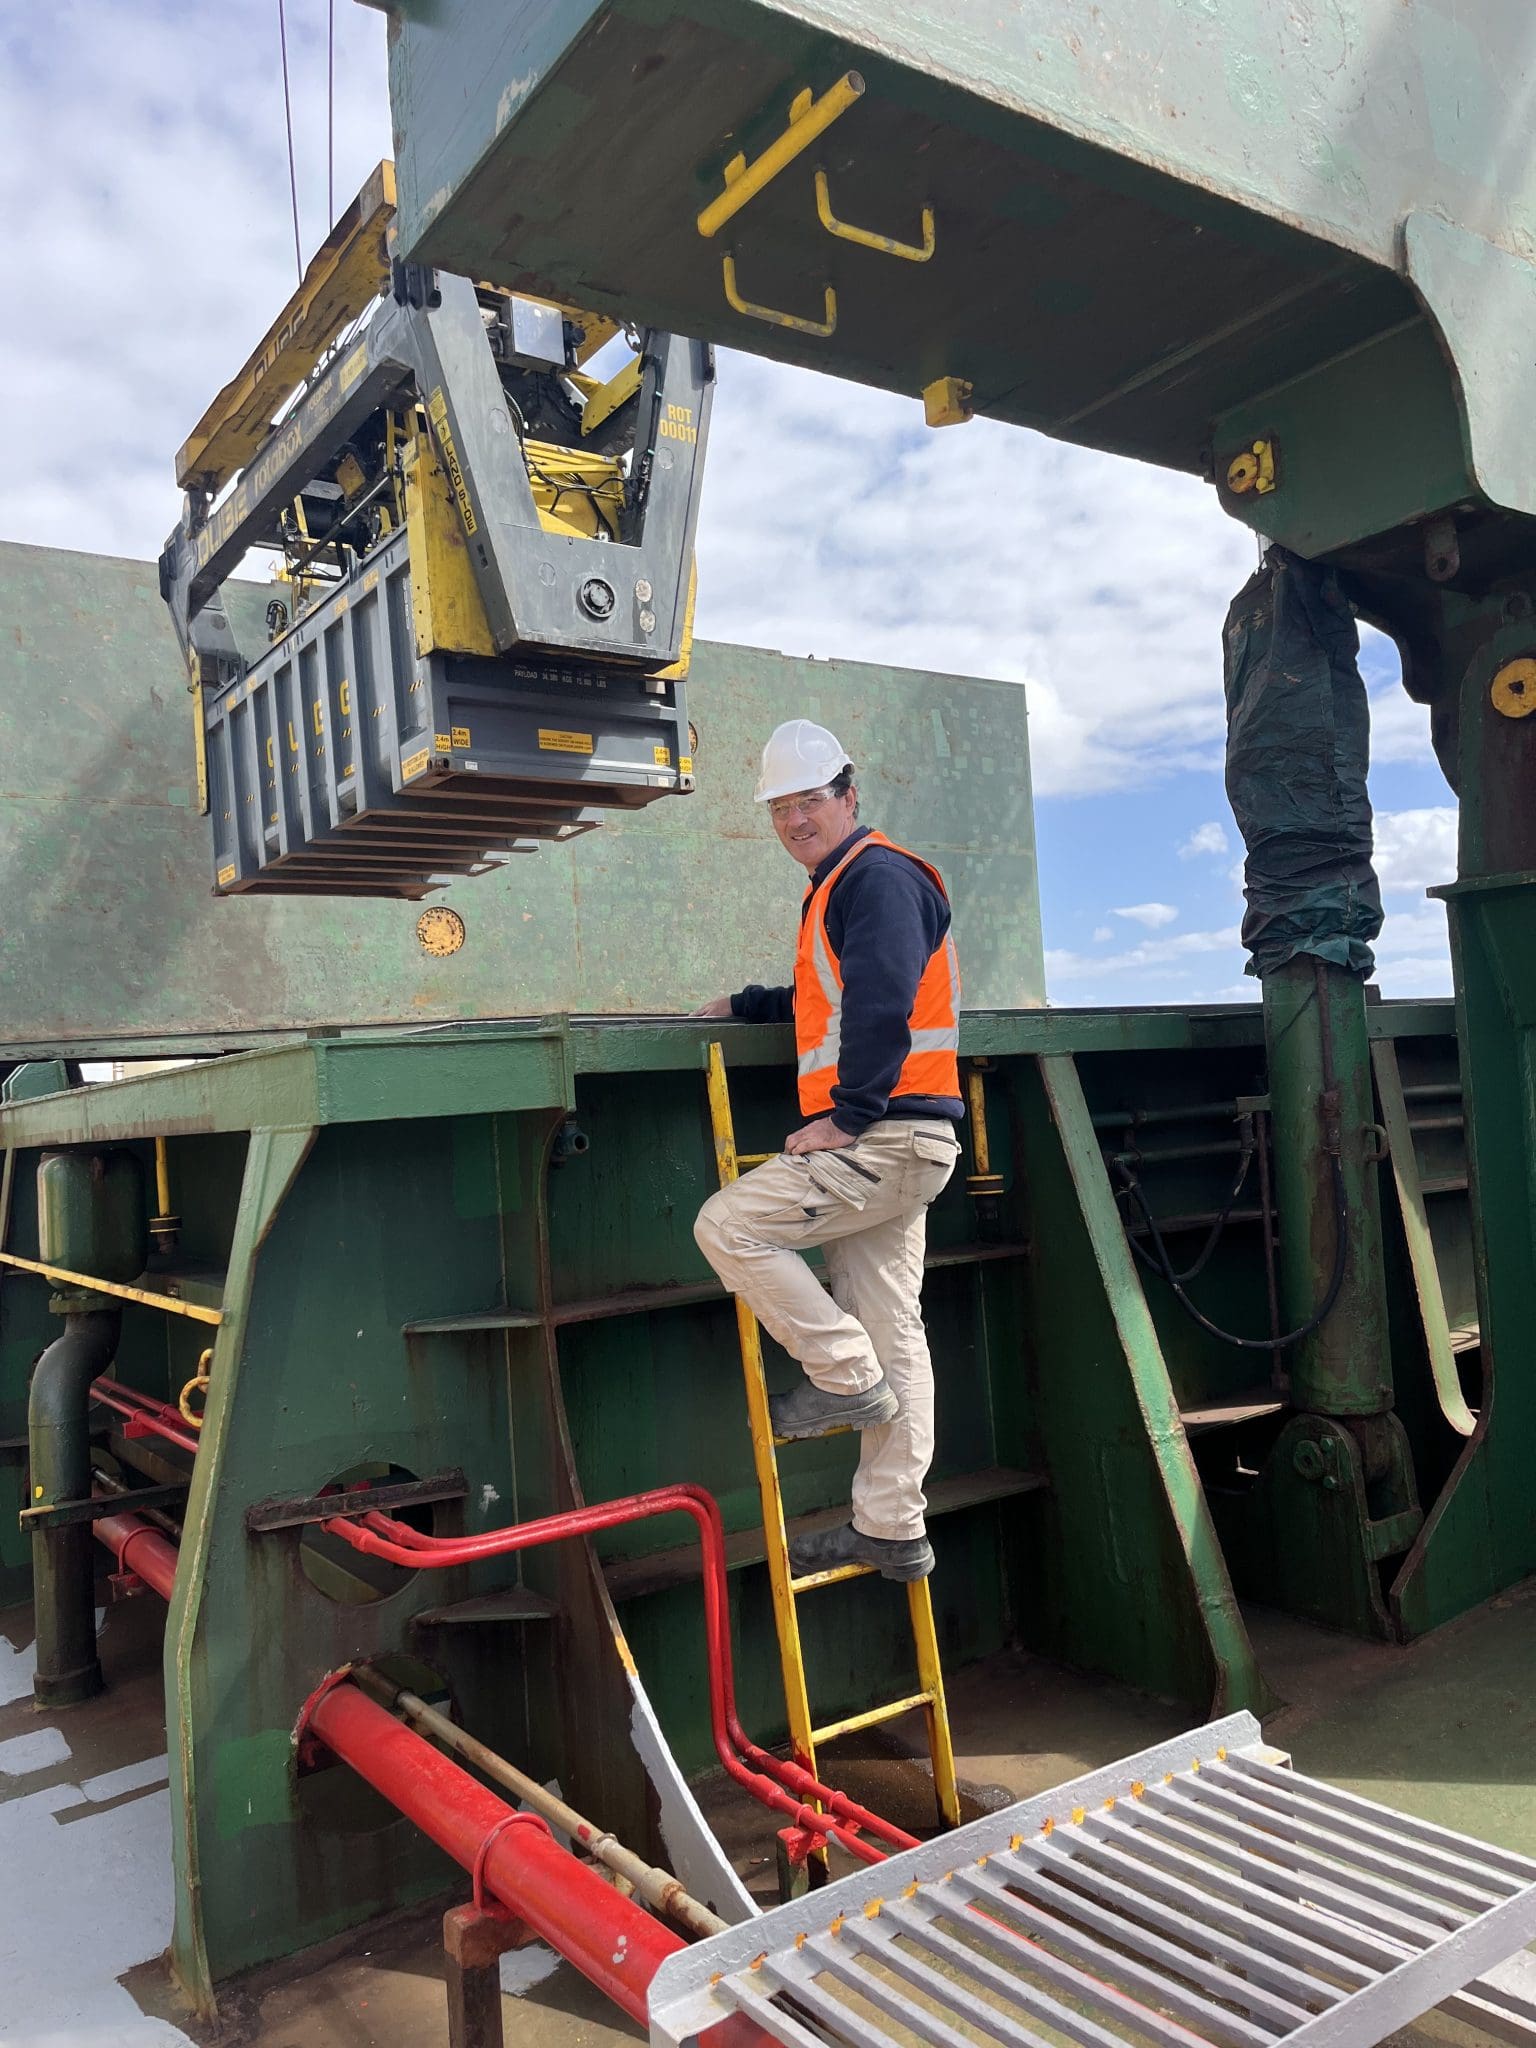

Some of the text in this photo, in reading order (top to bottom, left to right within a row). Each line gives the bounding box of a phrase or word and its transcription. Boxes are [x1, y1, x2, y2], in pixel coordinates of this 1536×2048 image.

[667, 403, 692, 424] ROT
[660, 418, 697, 444] 00011
[445, 446, 475, 531] LAND SIDE
[514, 669, 538, 679] PAYLOAD
[453, 738, 469, 746] WIDE
